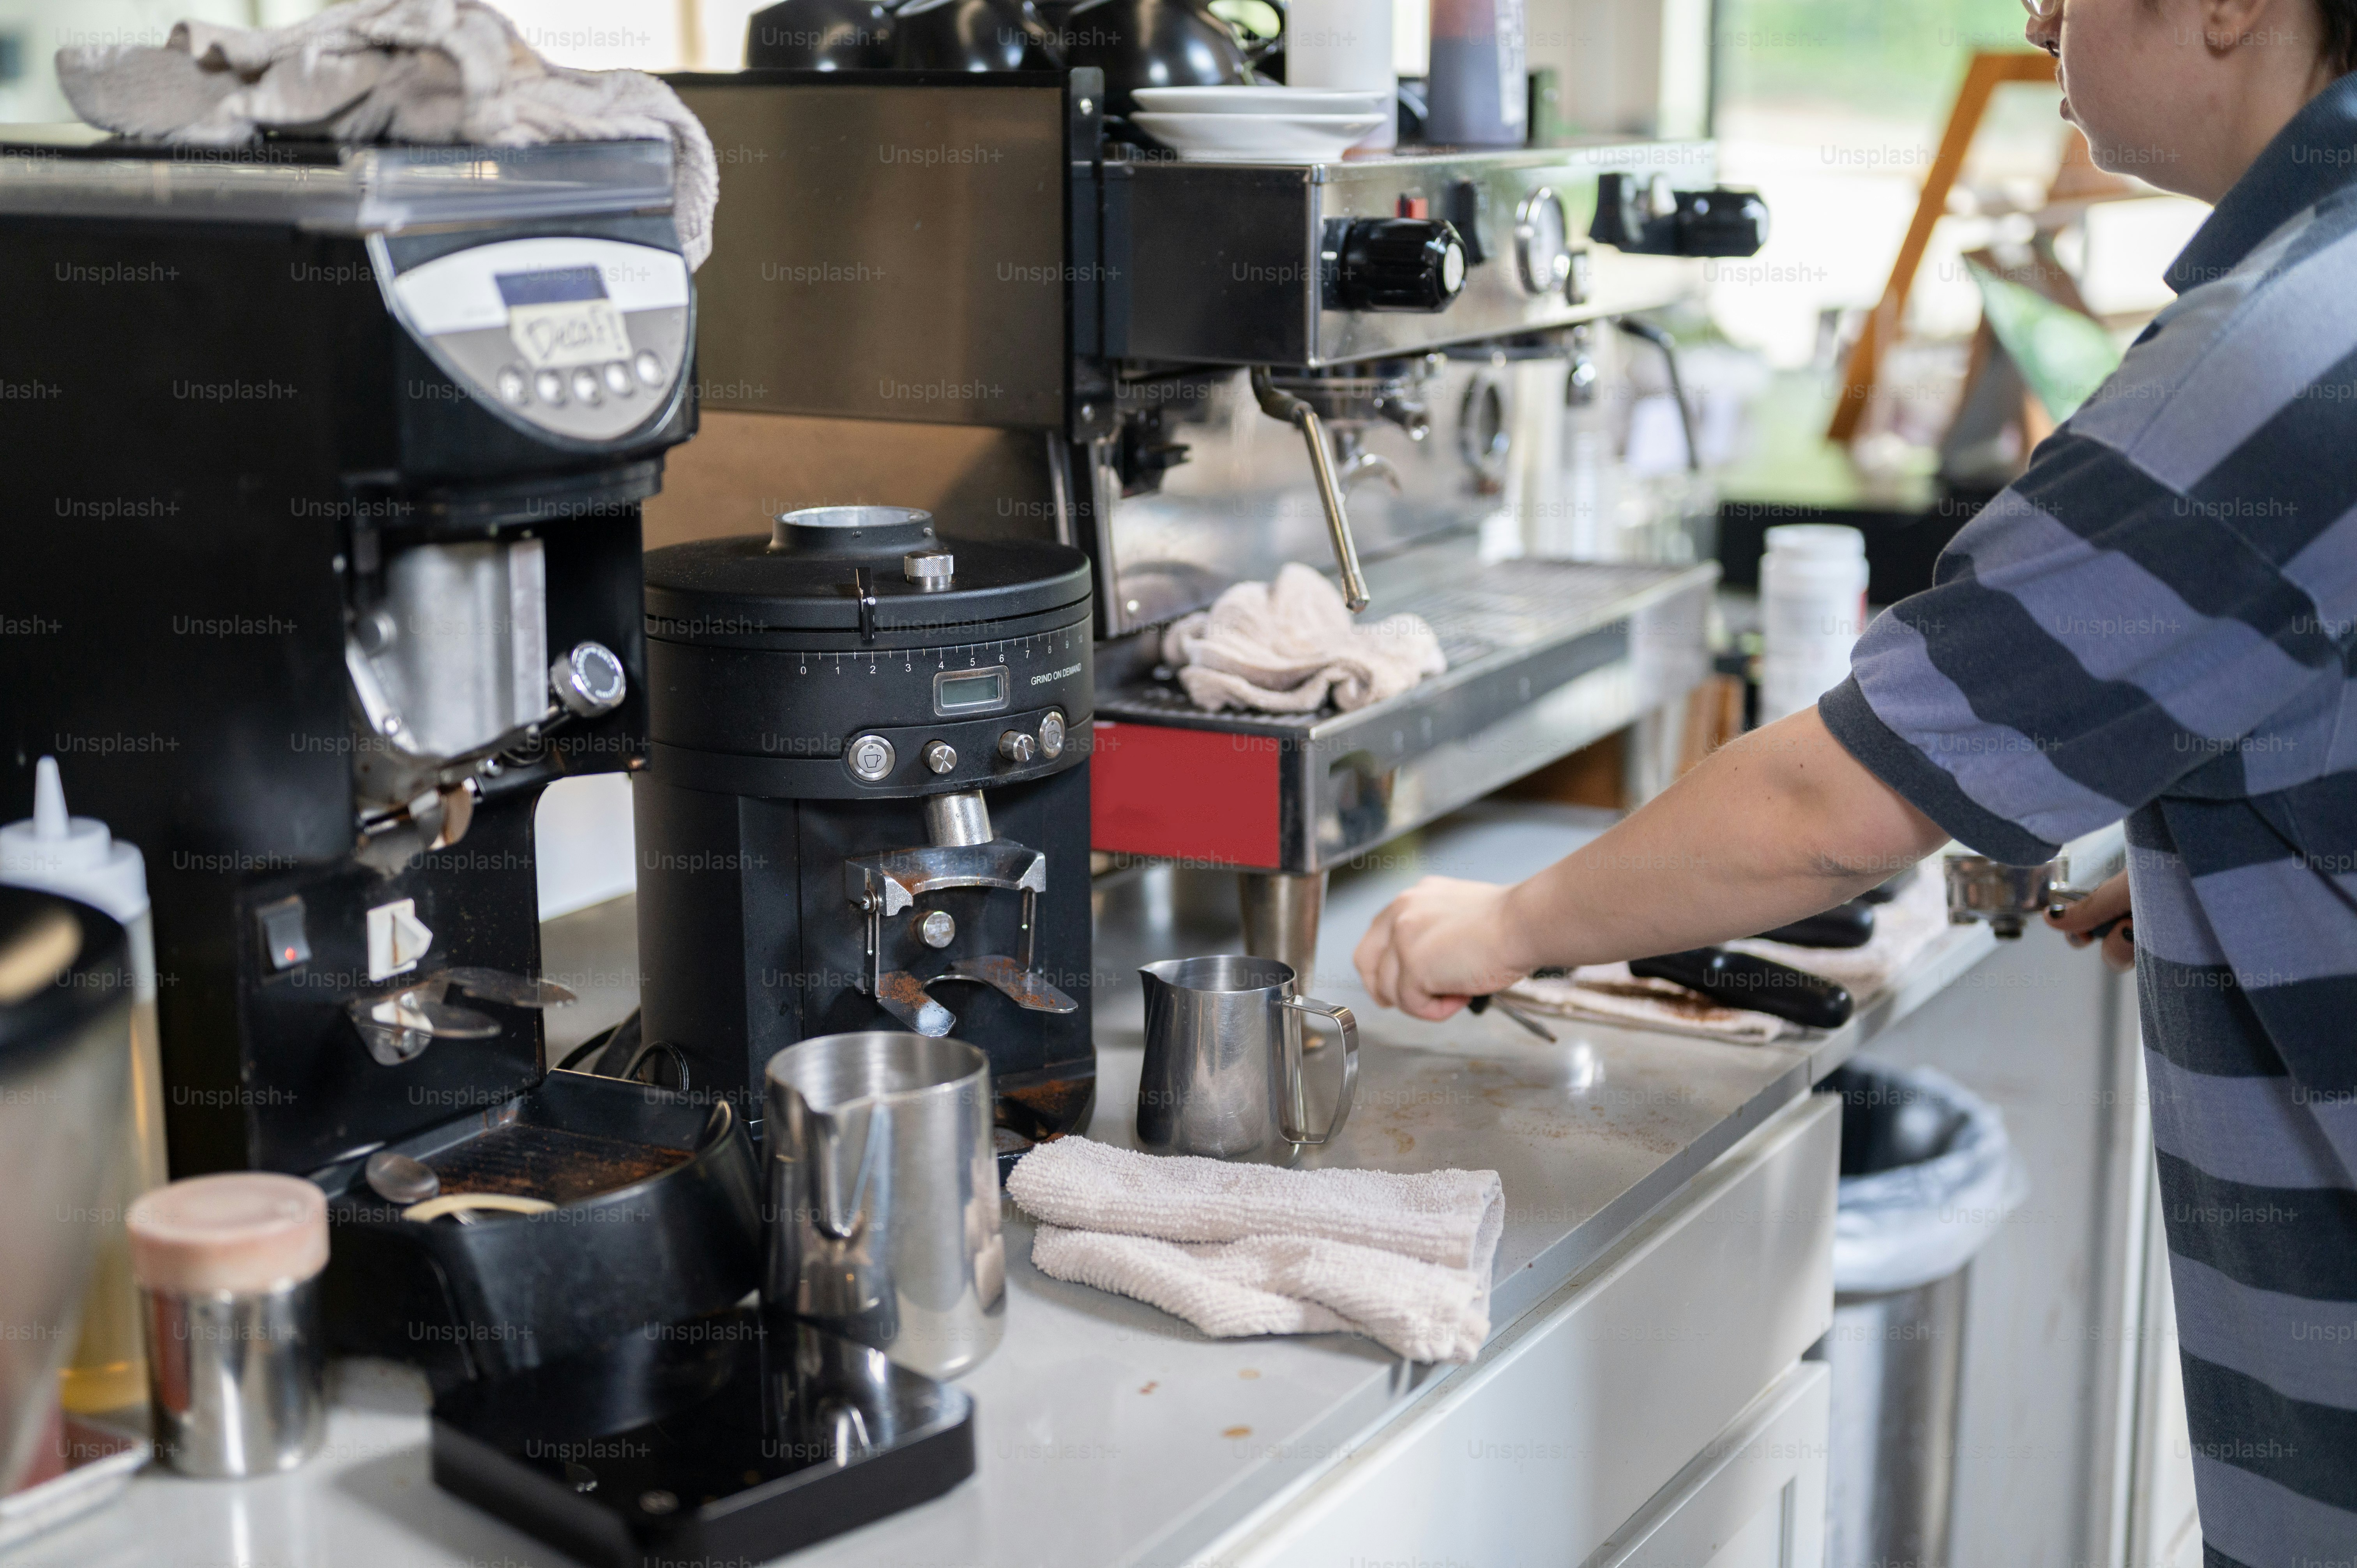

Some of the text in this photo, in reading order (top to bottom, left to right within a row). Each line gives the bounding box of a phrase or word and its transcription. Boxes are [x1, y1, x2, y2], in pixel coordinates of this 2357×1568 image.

[800, 666, 806, 675] 0
[835, 666, 839, 675] 1
[870, 666, 876, 674] 2
[905, 664, 911, 672] 3
[938, 661, 944, 669] 4
[970, 658, 975, 666] 5
[999, 654, 1004, 662] 6
[1025, 650, 1030, 659] 7
[1048, 645, 1052, 653] 8
[1065, 640, 1069, 649] 9
[1031, 662, 1081, 685] GRIND ON DEMAND
